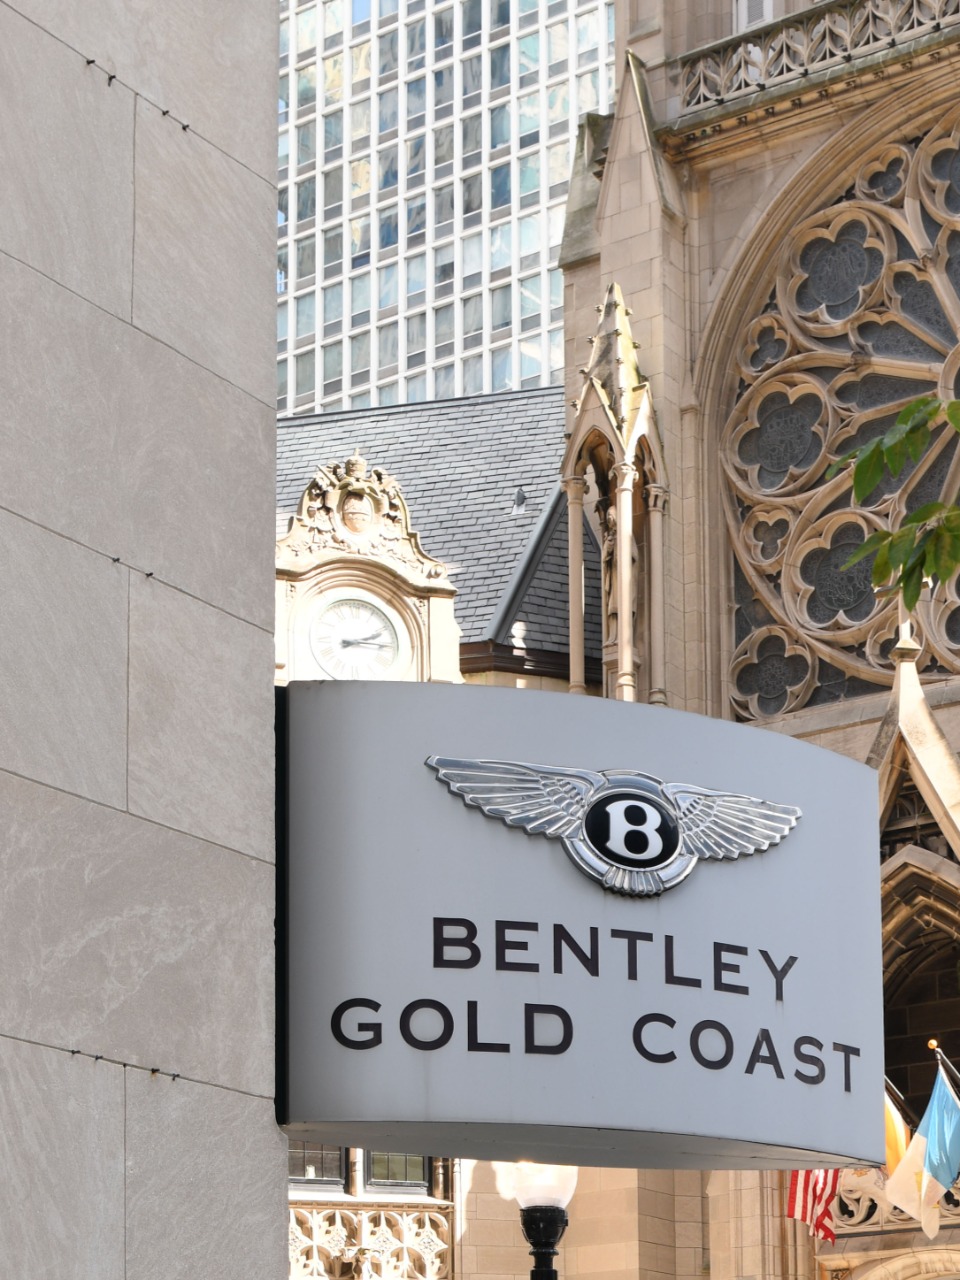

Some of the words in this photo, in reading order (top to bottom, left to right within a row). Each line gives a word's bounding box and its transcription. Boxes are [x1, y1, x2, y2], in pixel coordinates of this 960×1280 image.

[605, 800, 662, 860] B
[432, 916, 799, 1002] BENTLEY
[330, 997, 574, 1056] GOLD
[632, 1012, 861, 1093] COAST
